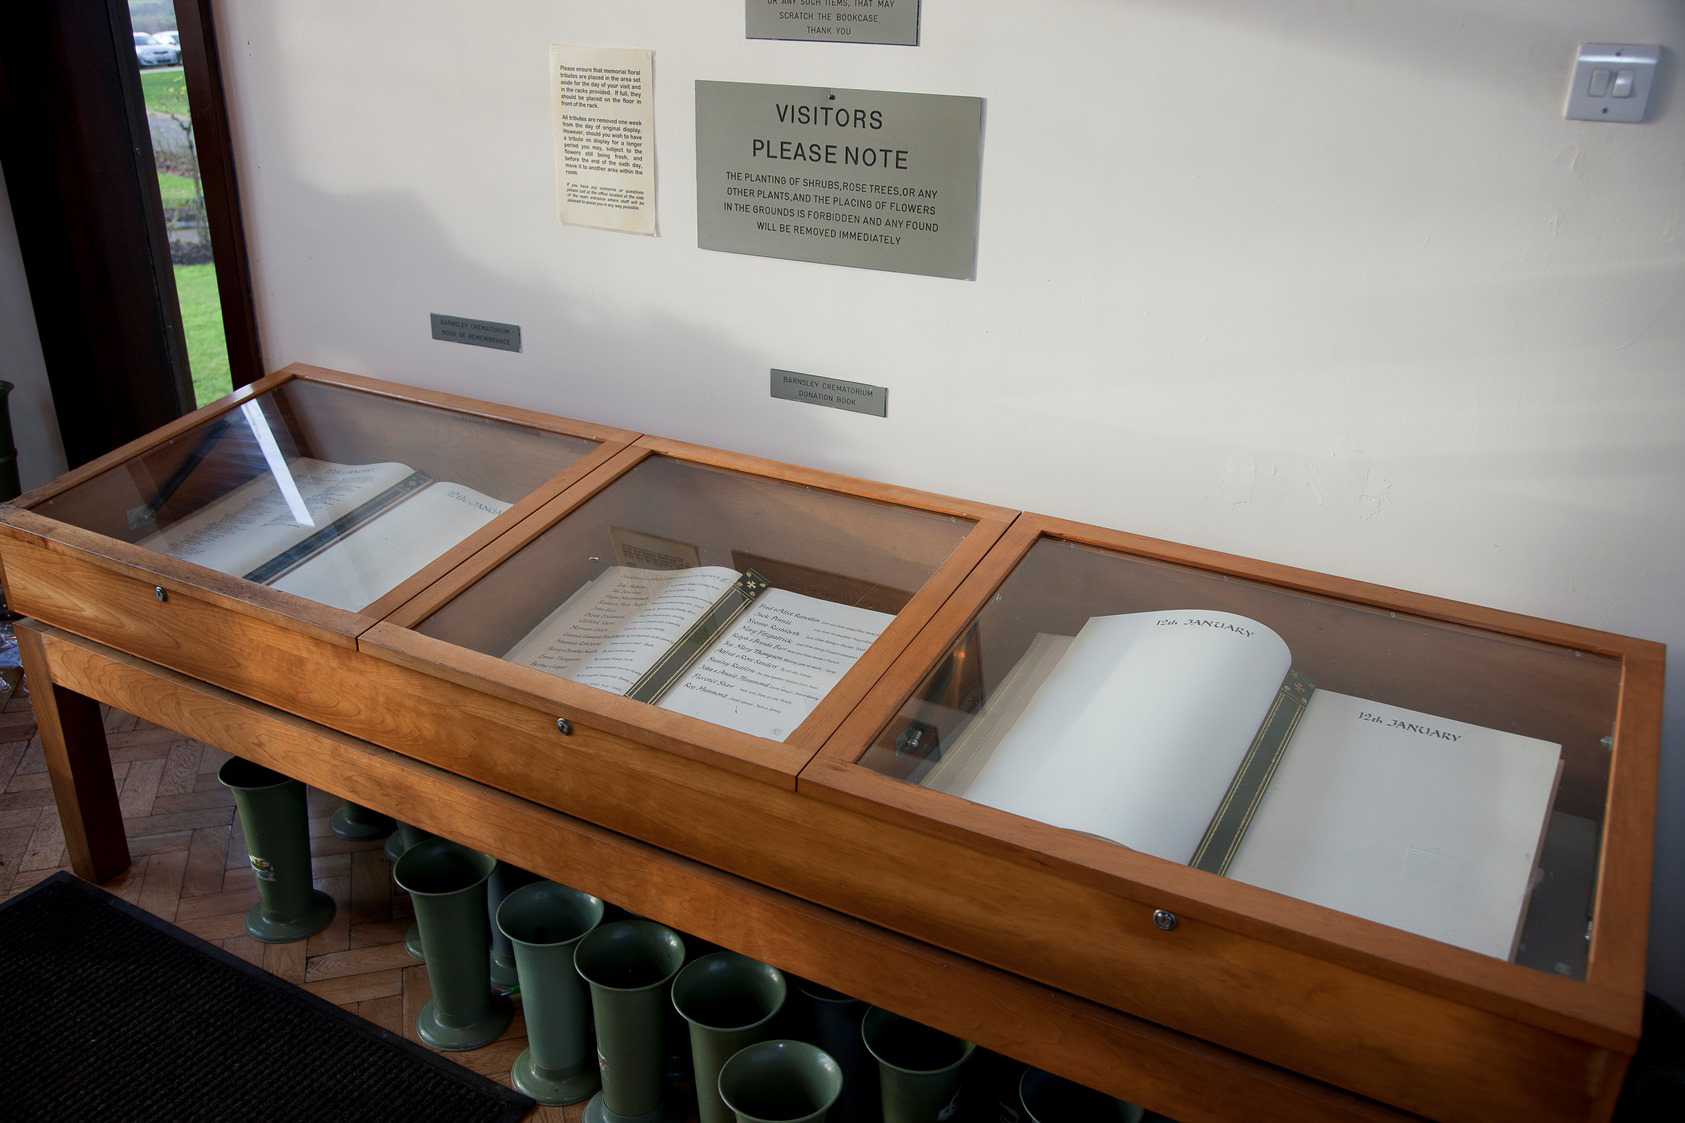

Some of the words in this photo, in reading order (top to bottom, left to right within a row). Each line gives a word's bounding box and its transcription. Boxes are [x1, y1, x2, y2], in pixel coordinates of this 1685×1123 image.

[878, 0, 895, 8] MAY
[779, 12, 813, 20] SCRATCH
[818, 13, 831, 21] THE
[836, 13, 878, 23] BOOKCASE
[807, 26, 831, 34] THANK
[836, 27, 851, 35] YOU
[776, 104, 883, 129] VISITORS
[753, 139, 837, 164] PLEASE
[845, 146, 909, 170] NOTE
[726, 171, 742, 181] THE
[744, 173, 787, 185] PLANTING
[789, 177, 801, 185] OF
[918, 189, 938, 199] ANY
[727, 187, 755, 197] OTHER
[814, 195, 830, 205] THE
[833, 196, 872, 208] PLACING
[875, 201, 887, 210] OF
[890, 202, 936, 215] FLOWERS
[724, 202, 732, 211] IN
[734, 203, 750, 213] THE
[753, 205, 795, 217] GROUNDS
[797, 209, 805, 218] IS
[808, 211, 860, 224] FORBIDDEN
[863, 216, 882, 226] AND
[885, 219, 903, 228] ANY
[906, 220, 939, 232] FOUND
[757, 222, 776, 232] WILL
[780, 224, 791, 233] BE
[794, 225, 836, 238] REMOVED
[840, 231, 901, 244] IMMEDIATELY
[783, 376, 818, 388] BARNSLEY
[822, 383, 873, 396] CREMATORIUM
[799, 390, 833, 401] DONATION
[837, 397, 856, 405] BOOK
[1184, 619, 1254, 637] JANUARY
[1359, 712, 1383, 724] 12th
[1387, 719, 1462, 741] JANUARY
